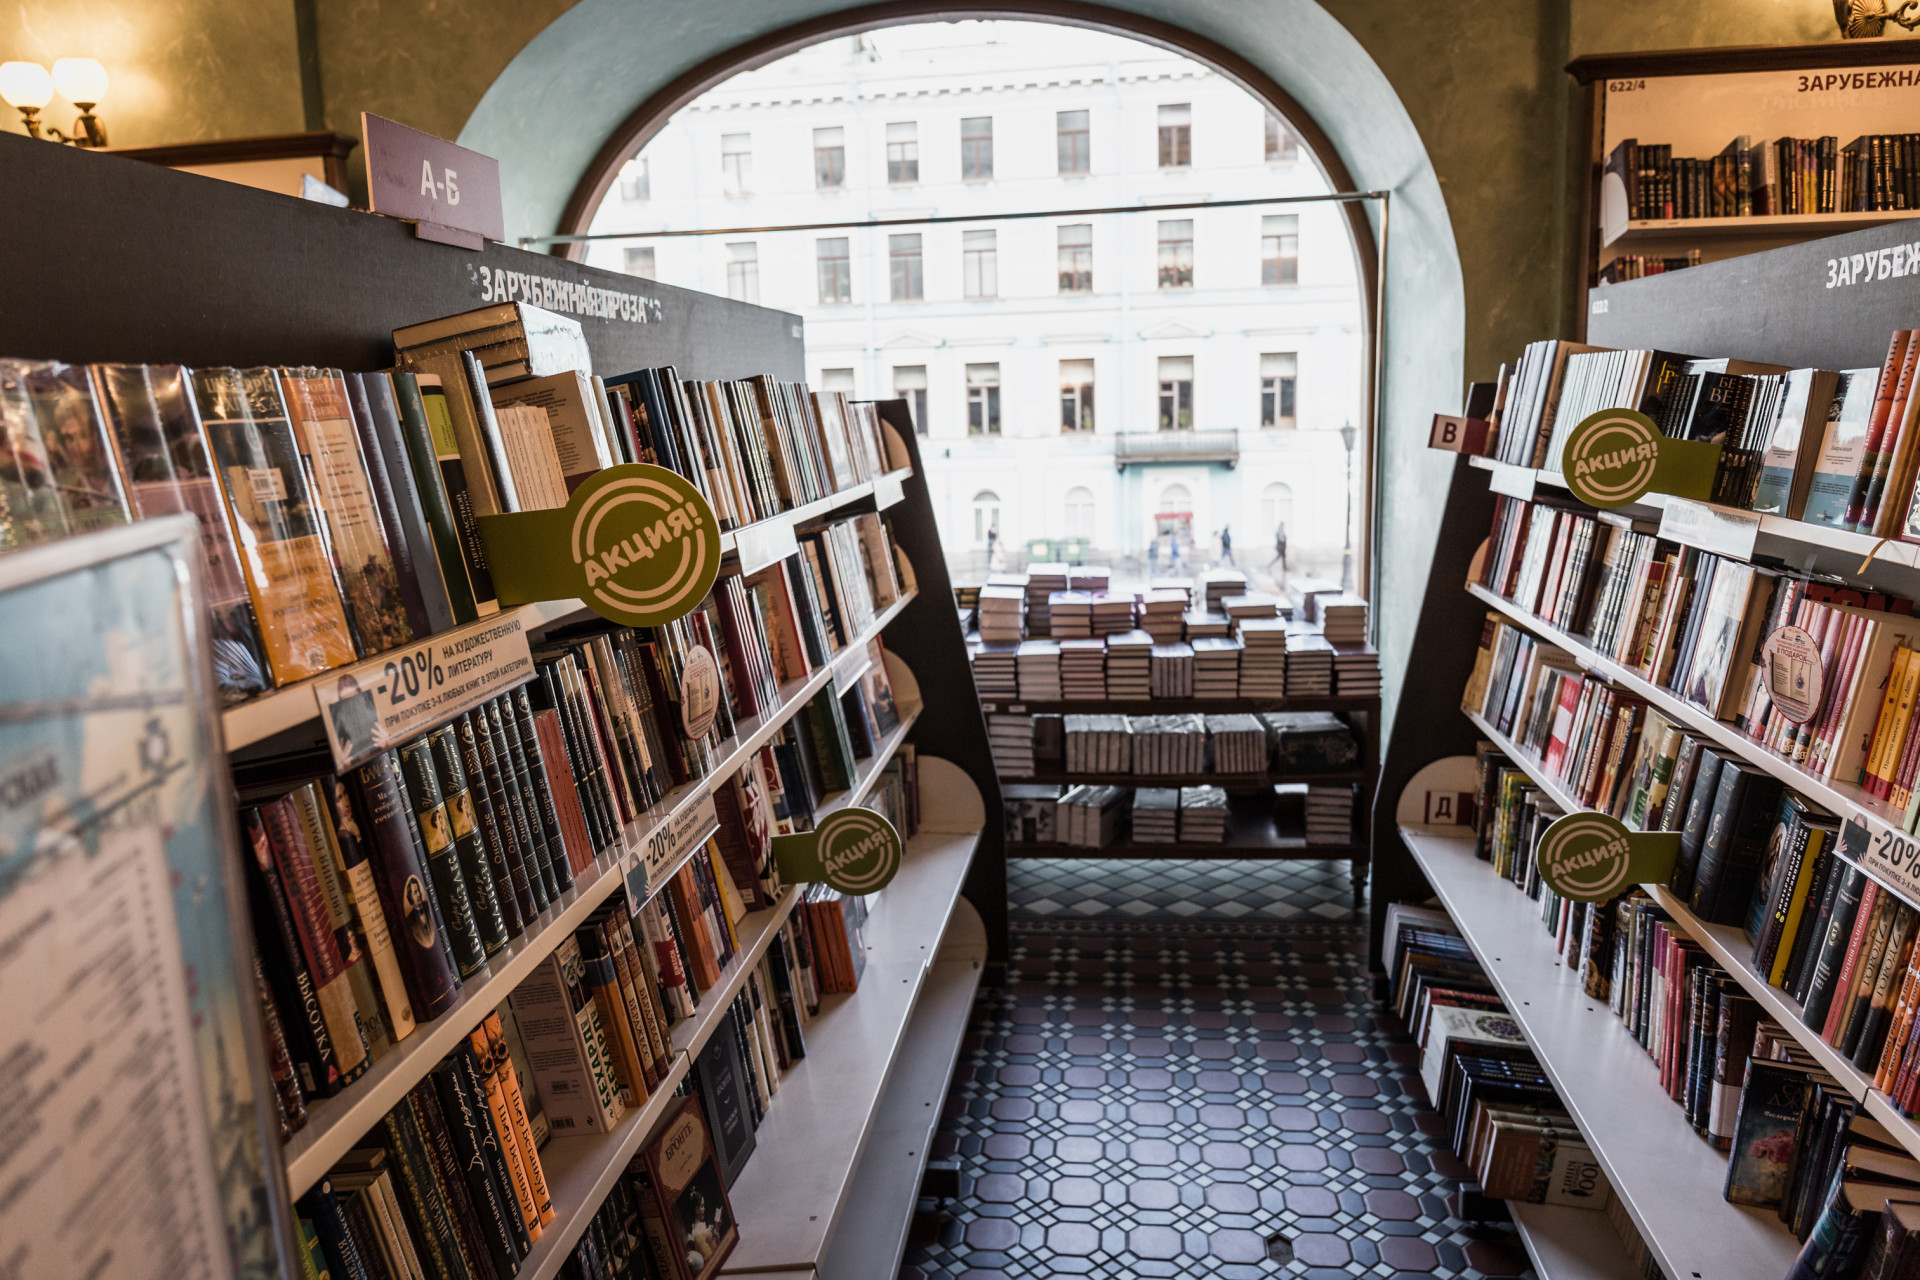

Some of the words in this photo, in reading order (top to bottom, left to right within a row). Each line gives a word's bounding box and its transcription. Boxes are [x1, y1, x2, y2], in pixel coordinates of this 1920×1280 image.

[1609, 79, 1646, 93] 622/4
[420, 158, 461, 206] А-Б
[1826, 242, 1920, 289] ЗАРУБЕЖ
[1441, 421, 1458, 444] В
[1574, 440, 1659, 477] АКЦИЯ!
[455, 493, 472, 539] ЧАСТНОЙ
[584, 501, 703, 587] АКЦИЯ!
[442, 645, 456, 659] НА
[456, 619, 521, 655] ХУДОЖЕСТВЕННУЮ
[1781, 648, 1807, 662] ПОДАРОК
[377, 647, 445, 706] -20%
[448, 649, 494, 678] ЛИТЕРАТУРУ
[385, 714, 401, 728] ПРИ
[400, 700, 431, 722] ПОКУПКЕ
[442, 687, 466, 705] ЛЮБЫХ
[466, 681, 481, 695] КНИГ
[486, 671, 500, 684] ЭТОЙ
[500, 657, 529, 677] КАТЕГОРИИ
[515, 808, 528, 844] Оноре
[527, 800, 540, 834] Оноре
[541, 791, 554, 825] Оноре
[1434, 796, 1452, 819] Д
[487, 829, 502, 864] Оноре
[502, 819, 516, 854] Оноре
[645, 822, 676, 867] -20%
[823, 828, 892, 876] АКЦИЯ!
[1551, 837, 1630, 879] АКЦИЯ!
[1874, 829, 1920, 879] -20%
[319, 854, 344, 917] ЕВГЕНИЯ
[1868, 856, 1879, 868] ПРИ
[1878, 862, 1901, 883] ПОКУПКЕ
[1863, 938, 1881, 987] ГОРОД
[1877, 946, 1897, 998] ГОРОД
[296, 971, 333, 1061] ВЫСОТКА
[628, 997, 651, 1062] БЕРАЖЕСС
[639, 988, 660, 1050] БЕРАЖЕСС
[1879, 1038, 1892, 1070] ДЖОН
[1889, 1016, 1899, 1039] ГРИН
[1888, 1048, 1898, 1078] ДЖОН
[1897, 1024, 1907, 1046] ГРИН
[468, 1129, 484, 1171] Дети
[483, 1109, 498, 1151] Дети
[511, 1090, 525, 1127] Пьер
[522, 1128, 546, 1196] Бетанкур
[664, 1121, 694, 1161] БРОНТЕ
[435, 1130, 456, 1176] ТАРЗАН
[498, 1104, 512, 1143] Пьер
[508, 1145, 533, 1213] Бетанкур
[496, 1158, 512, 1201] БЕРБЕРЯН
[1579, 1161, 1600, 1191] 100
[425, 1183, 446, 1244] ТАРЗАНЕ
[484, 1178, 500, 1220] БЕРБЕРЯН
[510, 1202, 523, 1233] ВАСКЕН
[498, 1220, 511, 1254] ВАСКЕН
[650, 1235, 671, 1280] БРОНТЕ
